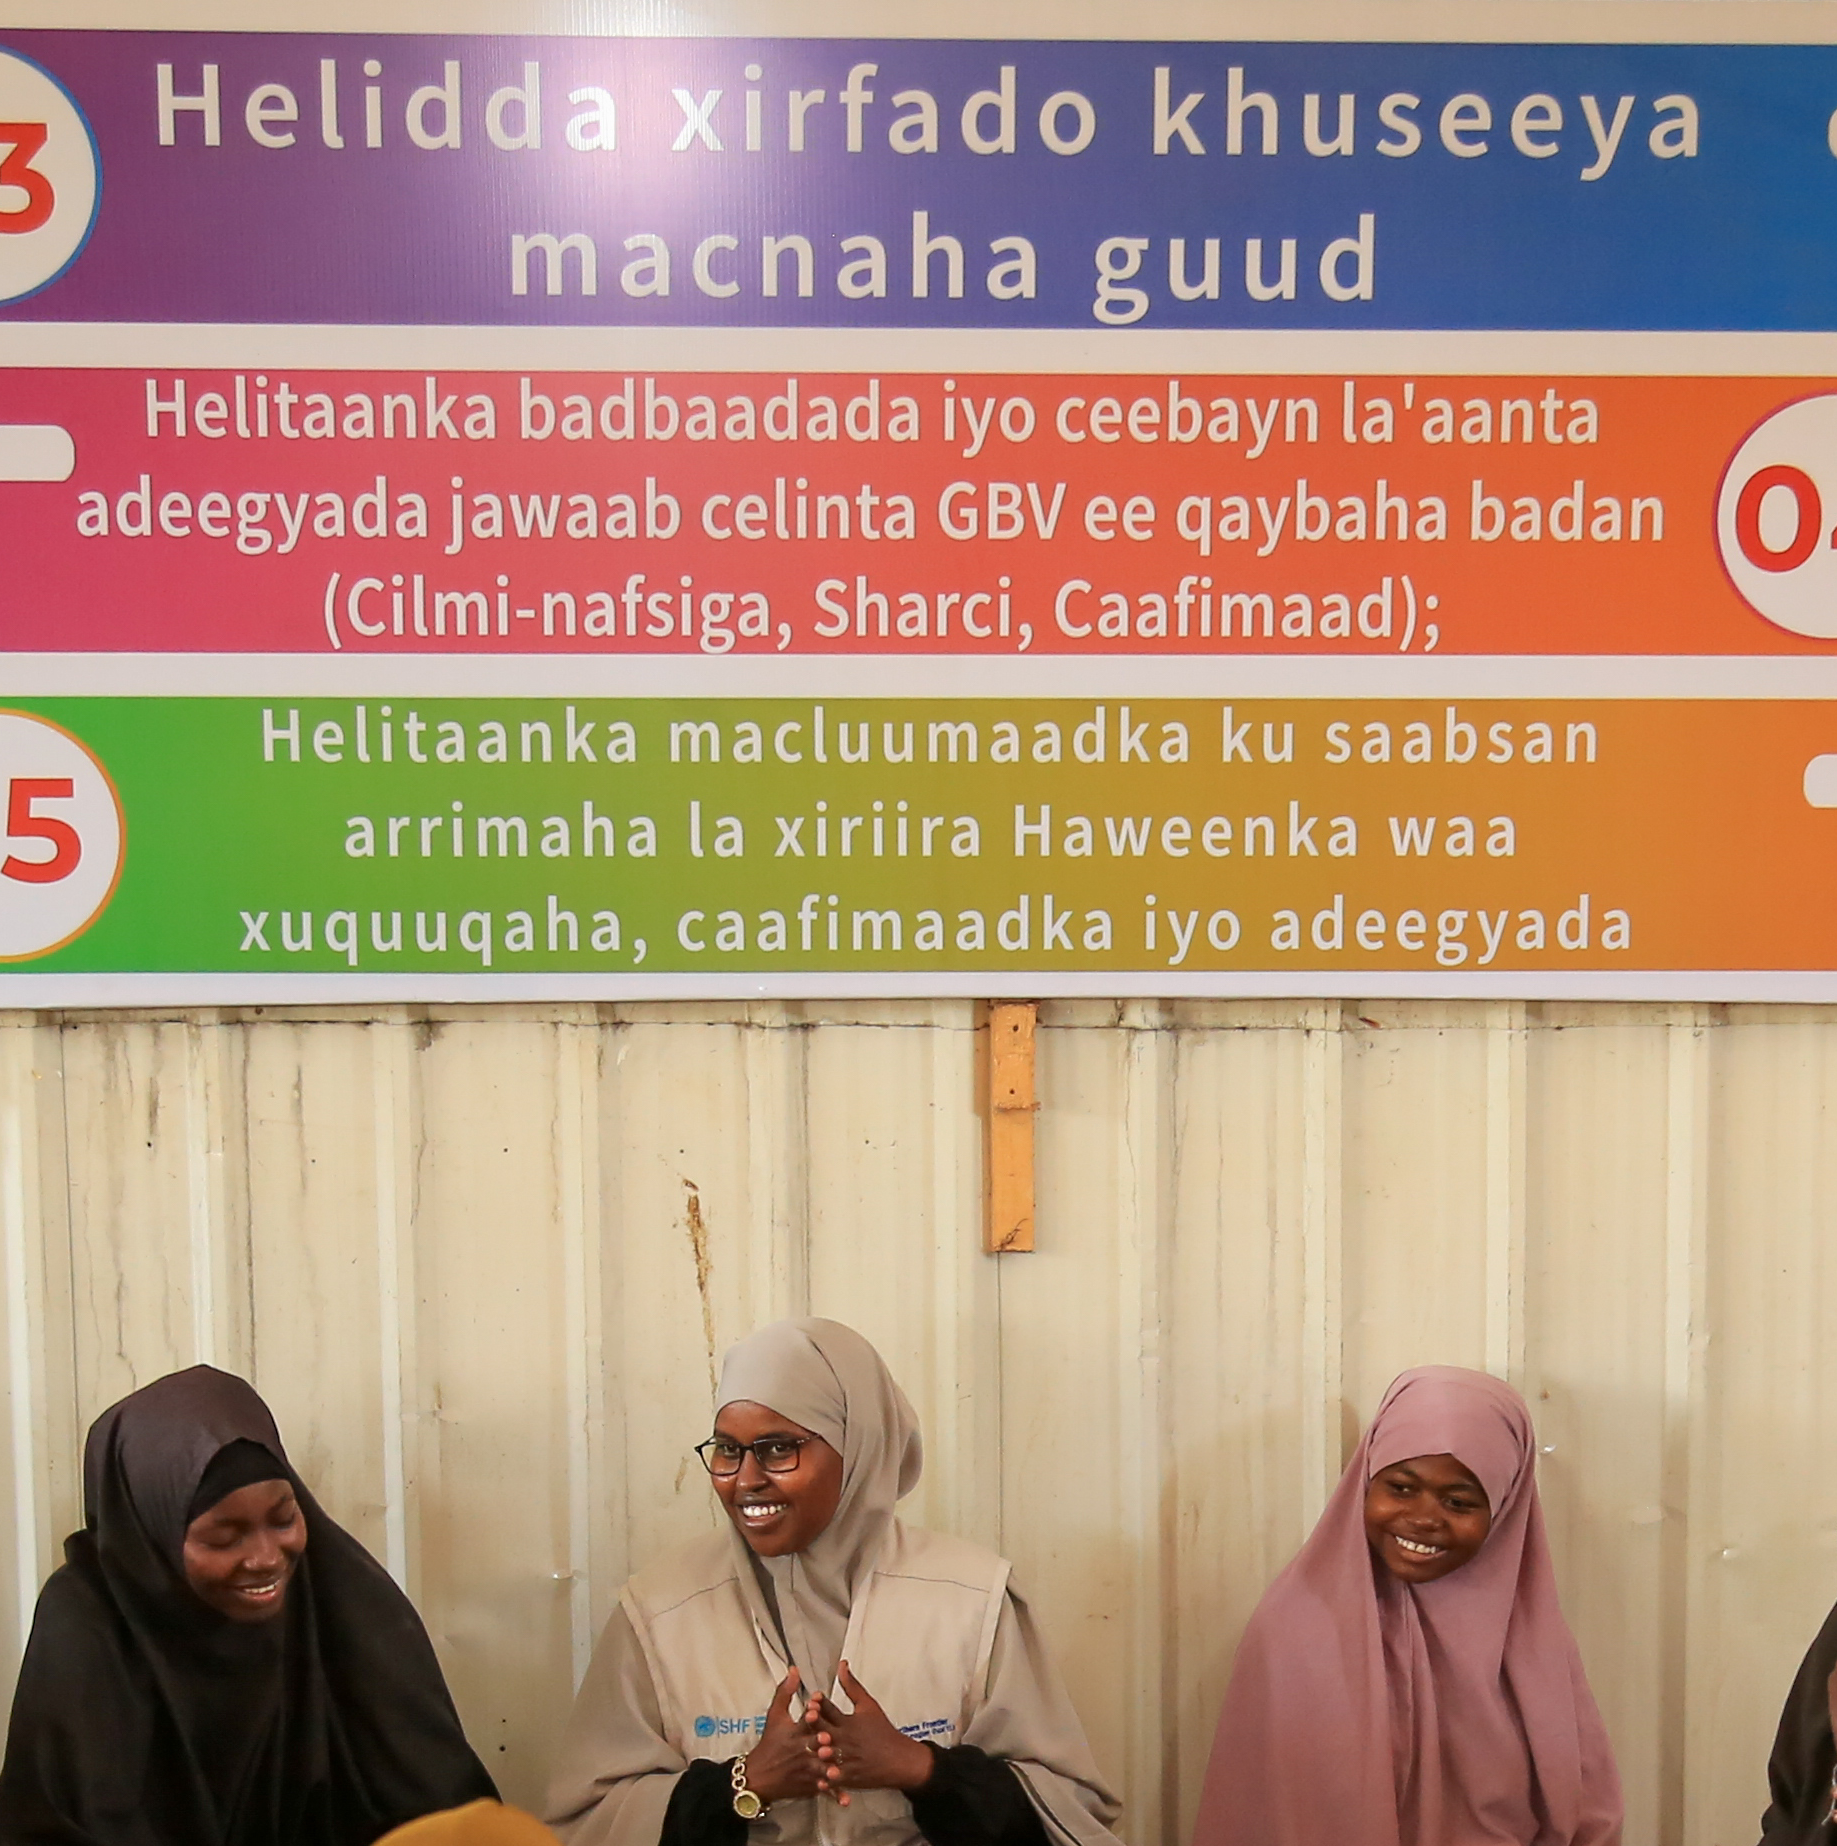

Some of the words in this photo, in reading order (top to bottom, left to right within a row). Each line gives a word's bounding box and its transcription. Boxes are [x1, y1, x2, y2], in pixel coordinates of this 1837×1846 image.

[155, 58, 619, 152] Helidda
[670, 64, 1098, 155] xirfado
[1152, 66, 1701, 182] khuseeya
[510, 210, 1040, 300] macnaha
[1092, 212, 1378, 324] guud
[145, 374, 497, 440] Helitaanka
[519, 376, 919, 441] badbaadada
[943, 378, 1036, 457] iyo
[1056, 379, 1319, 458] ceebayn
[1343, 380, 1598, 443] la'aanta
[76, 473, 428, 555] adeegyada
[444, 476, 681, 555] jawaab
[701, 476, 915, 540] celinta
[937, 480, 1067, 540] GBV
[1084, 495, 1156, 540] ee
[1176, 478, 1447, 556] qaybaha
[1471, 479, 1663, 541] badan
[321, 572, 792, 652] (Cilmi-nafsiga,
[813, 575, 1033, 651] Sharci,
[1055, 575, 1440, 651] Caafimaad);
[261, 703, 637, 764] Helitaanka
[669, 704, 1189, 763] macluumaadka
[1222, 705, 1294, 763] ku
[1325, 706, 1597, 763] saabsan
[343, 799, 657, 858] arrimaha
[689, 799, 745, 858] la
[774, 799, 981, 857] xiriira
[1013, 800, 1357, 857] Haweenka
[1389, 815, 1516, 857] waa
[239, 893, 648, 967] xuquuqaha,
[677, 892, 1113, 952] caafimaadka
[1145, 893, 1241, 965] iyo
[1271, 893, 1631, 966] adeegyada
[719, 1718, 751, 1734] SHF
